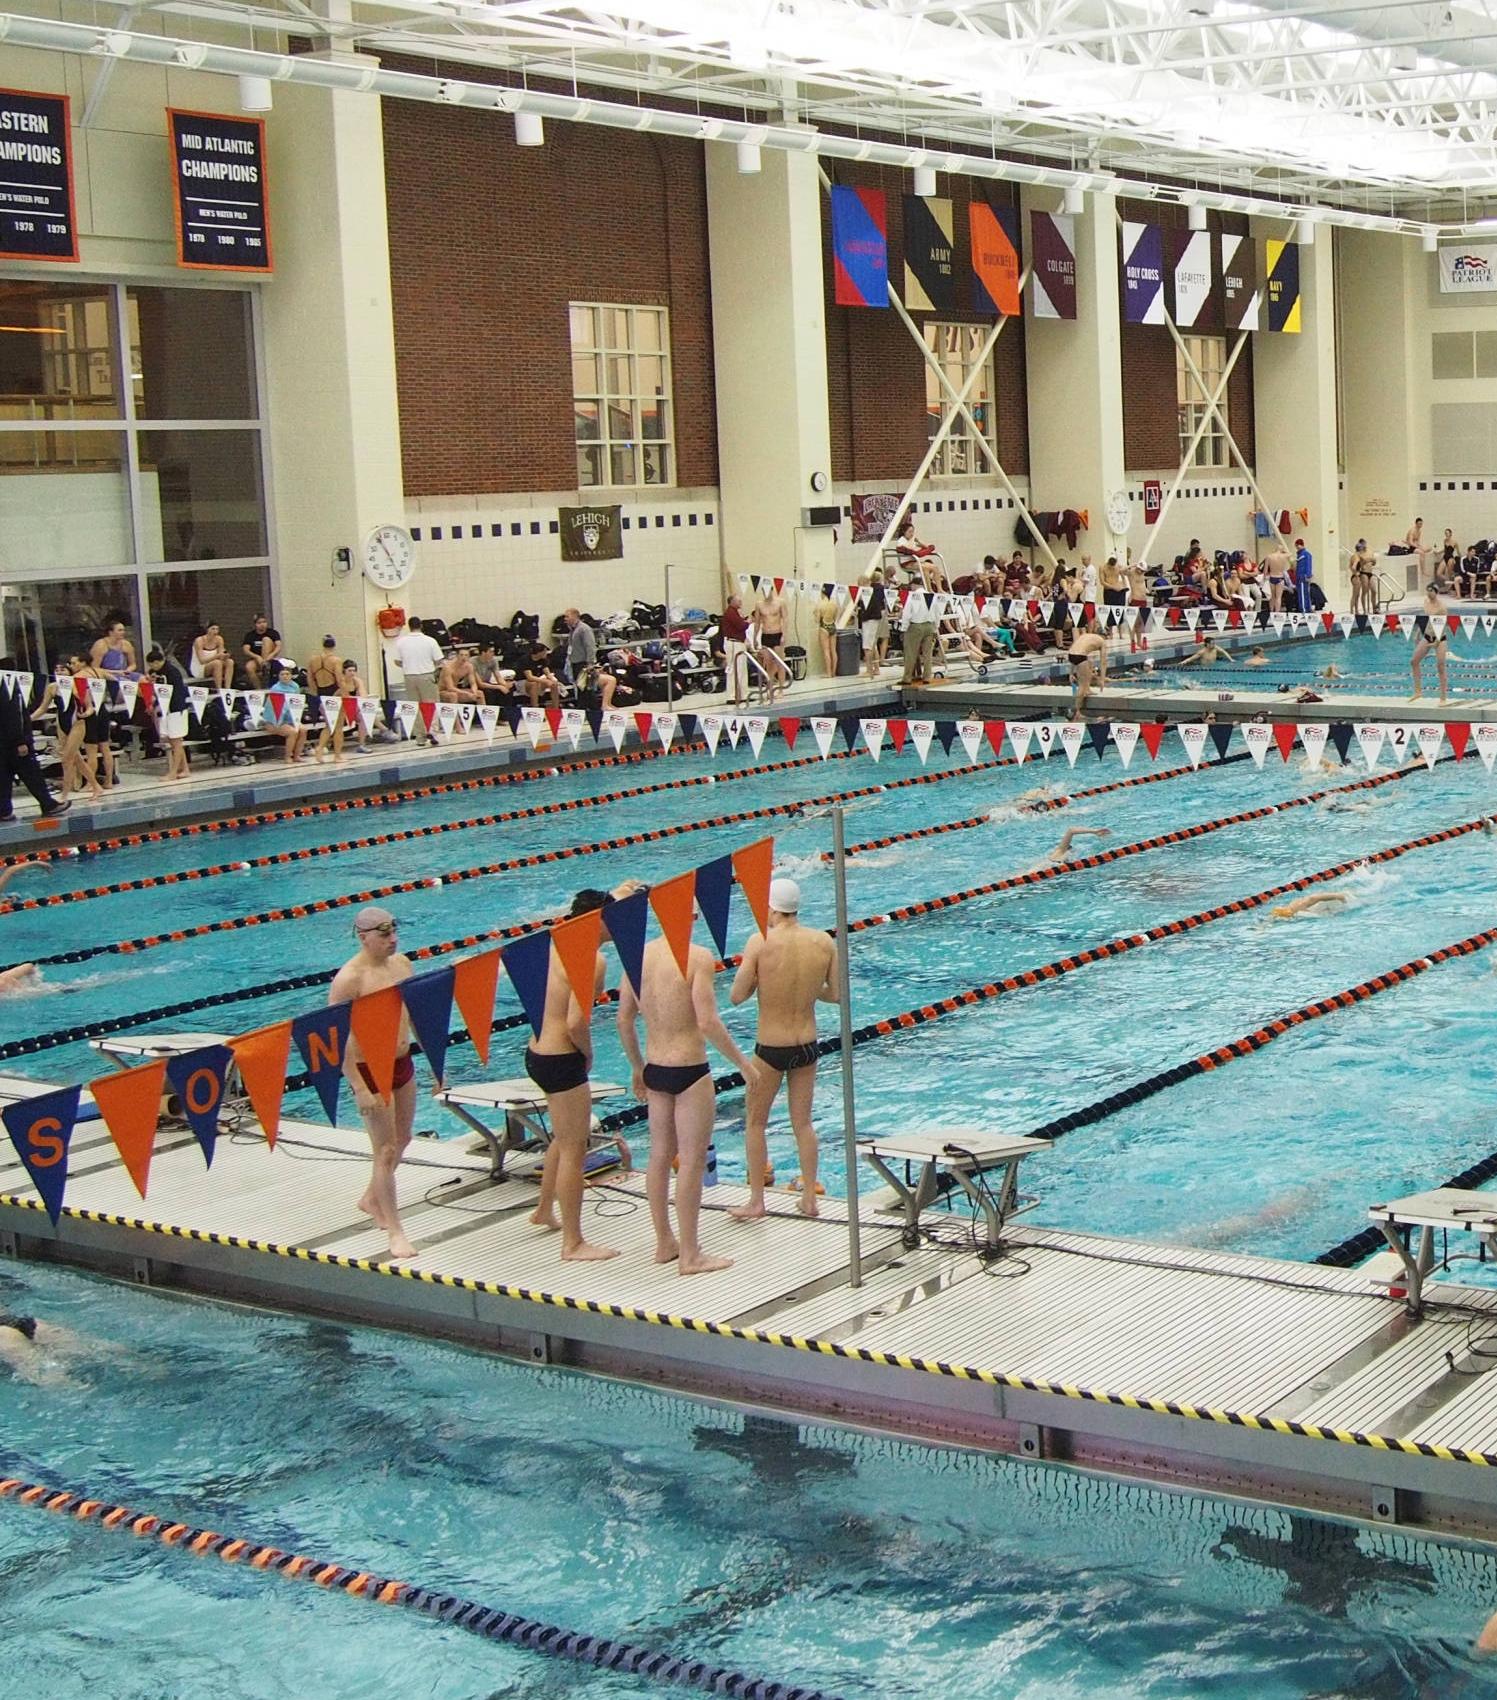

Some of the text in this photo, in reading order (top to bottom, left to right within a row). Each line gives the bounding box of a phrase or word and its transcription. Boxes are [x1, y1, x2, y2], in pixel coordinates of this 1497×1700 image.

[0, 111, 49, 134] STERN
[181, 133, 255, 155] MID ATLANTIC
[181, 159, 258, 183] CHAMPIONS
[14, 221, 67, 234] 1978 1979
[930, 247, 951, 263] ARMY
[1047, 259, 1074, 274] COLGATE
[1126, 266, 1160, 281] HOLY CROSS
[1452, 269, 1492, 277] PATRIOT
[1452, 275, 1494, 283] LEAGUE
[571, 512, 610, 528] LEHIGH
[1292, 615, 1298, 624] 5
[1486, 616, 1492, 626] 4
[225, 693, 232, 706] 6
[463, 706, 470, 721] 5
[730, 718, 738, 735] 4
[1041, 726, 1050, 742] 3
[1395, 728, 1405, 745] 2
[27, 1026, 340, 1168] S O N
